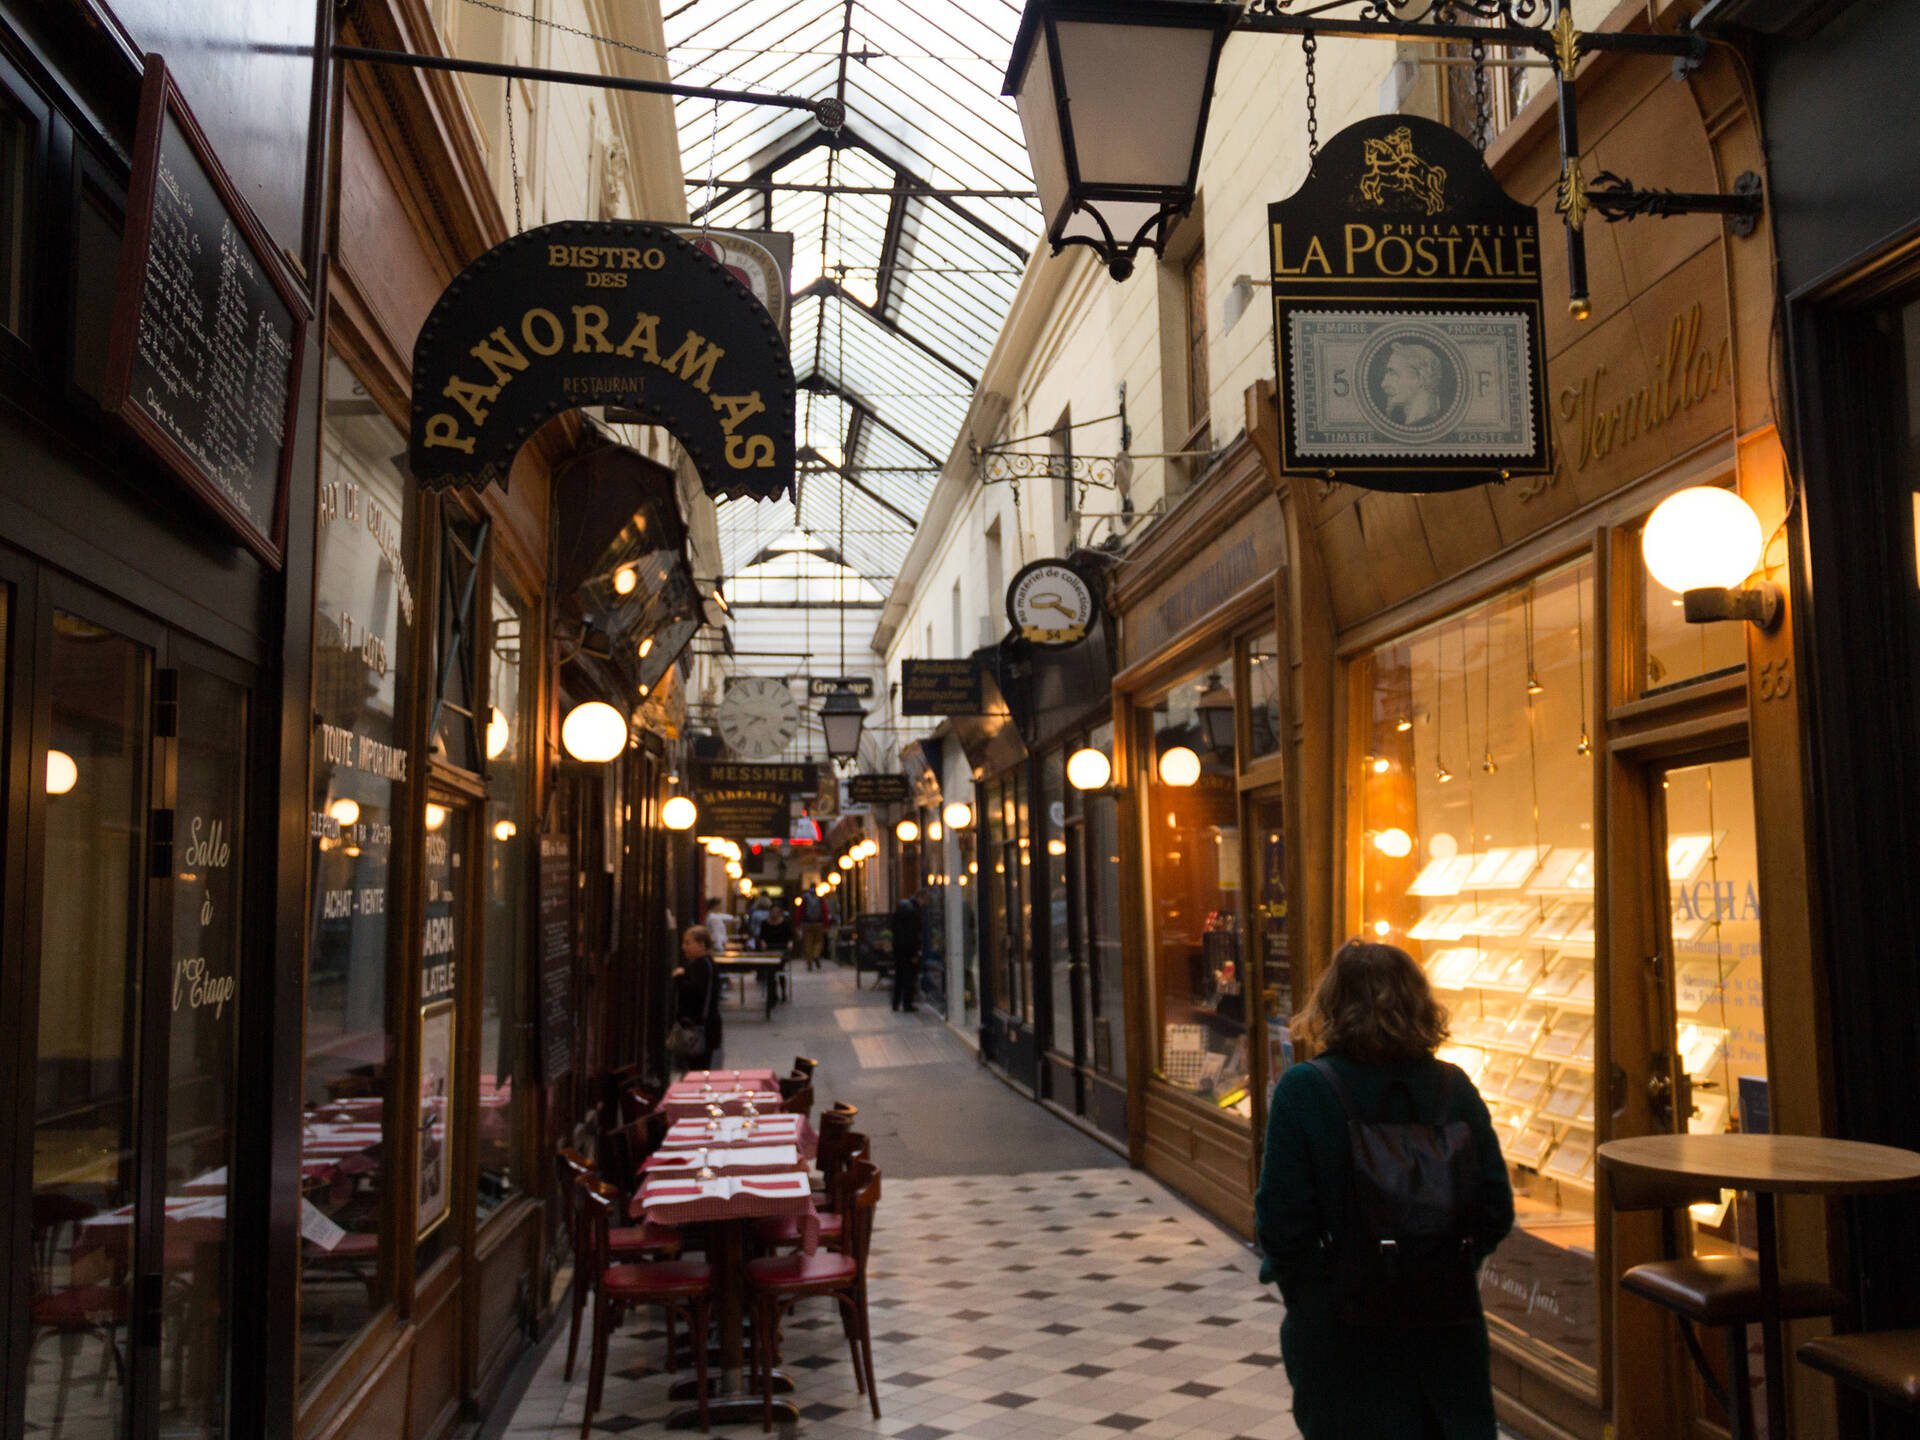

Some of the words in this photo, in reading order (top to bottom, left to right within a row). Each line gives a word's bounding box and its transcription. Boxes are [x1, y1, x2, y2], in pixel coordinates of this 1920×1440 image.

[1383, 223, 1536, 237] PHILATELIE
[548, 244, 665, 271] BISTRO
[1273, 223, 1332, 275] LA
[1345, 223, 1537, 276] POSTALE
[585, 272, 628, 288] DES
[1316, 322, 1369, 335] EMPIRE
[424, 304, 775, 470] PANORAMAS
[562, 376, 645, 394] RESTAURANT
[1332, 369, 1351, 398] 5
[1477, 370, 1494, 398] F
[1323, 432, 1375, 443] TIMBRE
[1458, 432, 1504, 443] POSTE
[1046, 567, 1060, 577] de
[322, 723, 354, 767] TOUTE
[358, 734, 408, 782] IMPORTANCE
[711, 766, 805, 782] MESSMER
[186, 816, 230, 867] Salle
[201, 889, 213, 926] à
[323, 890, 353, 920] ACHAT
[359, 888, 384, 915] VENTE
[1676, 880, 1760, 922] ACHA
[422, 962, 455, 998] ILATELIE
